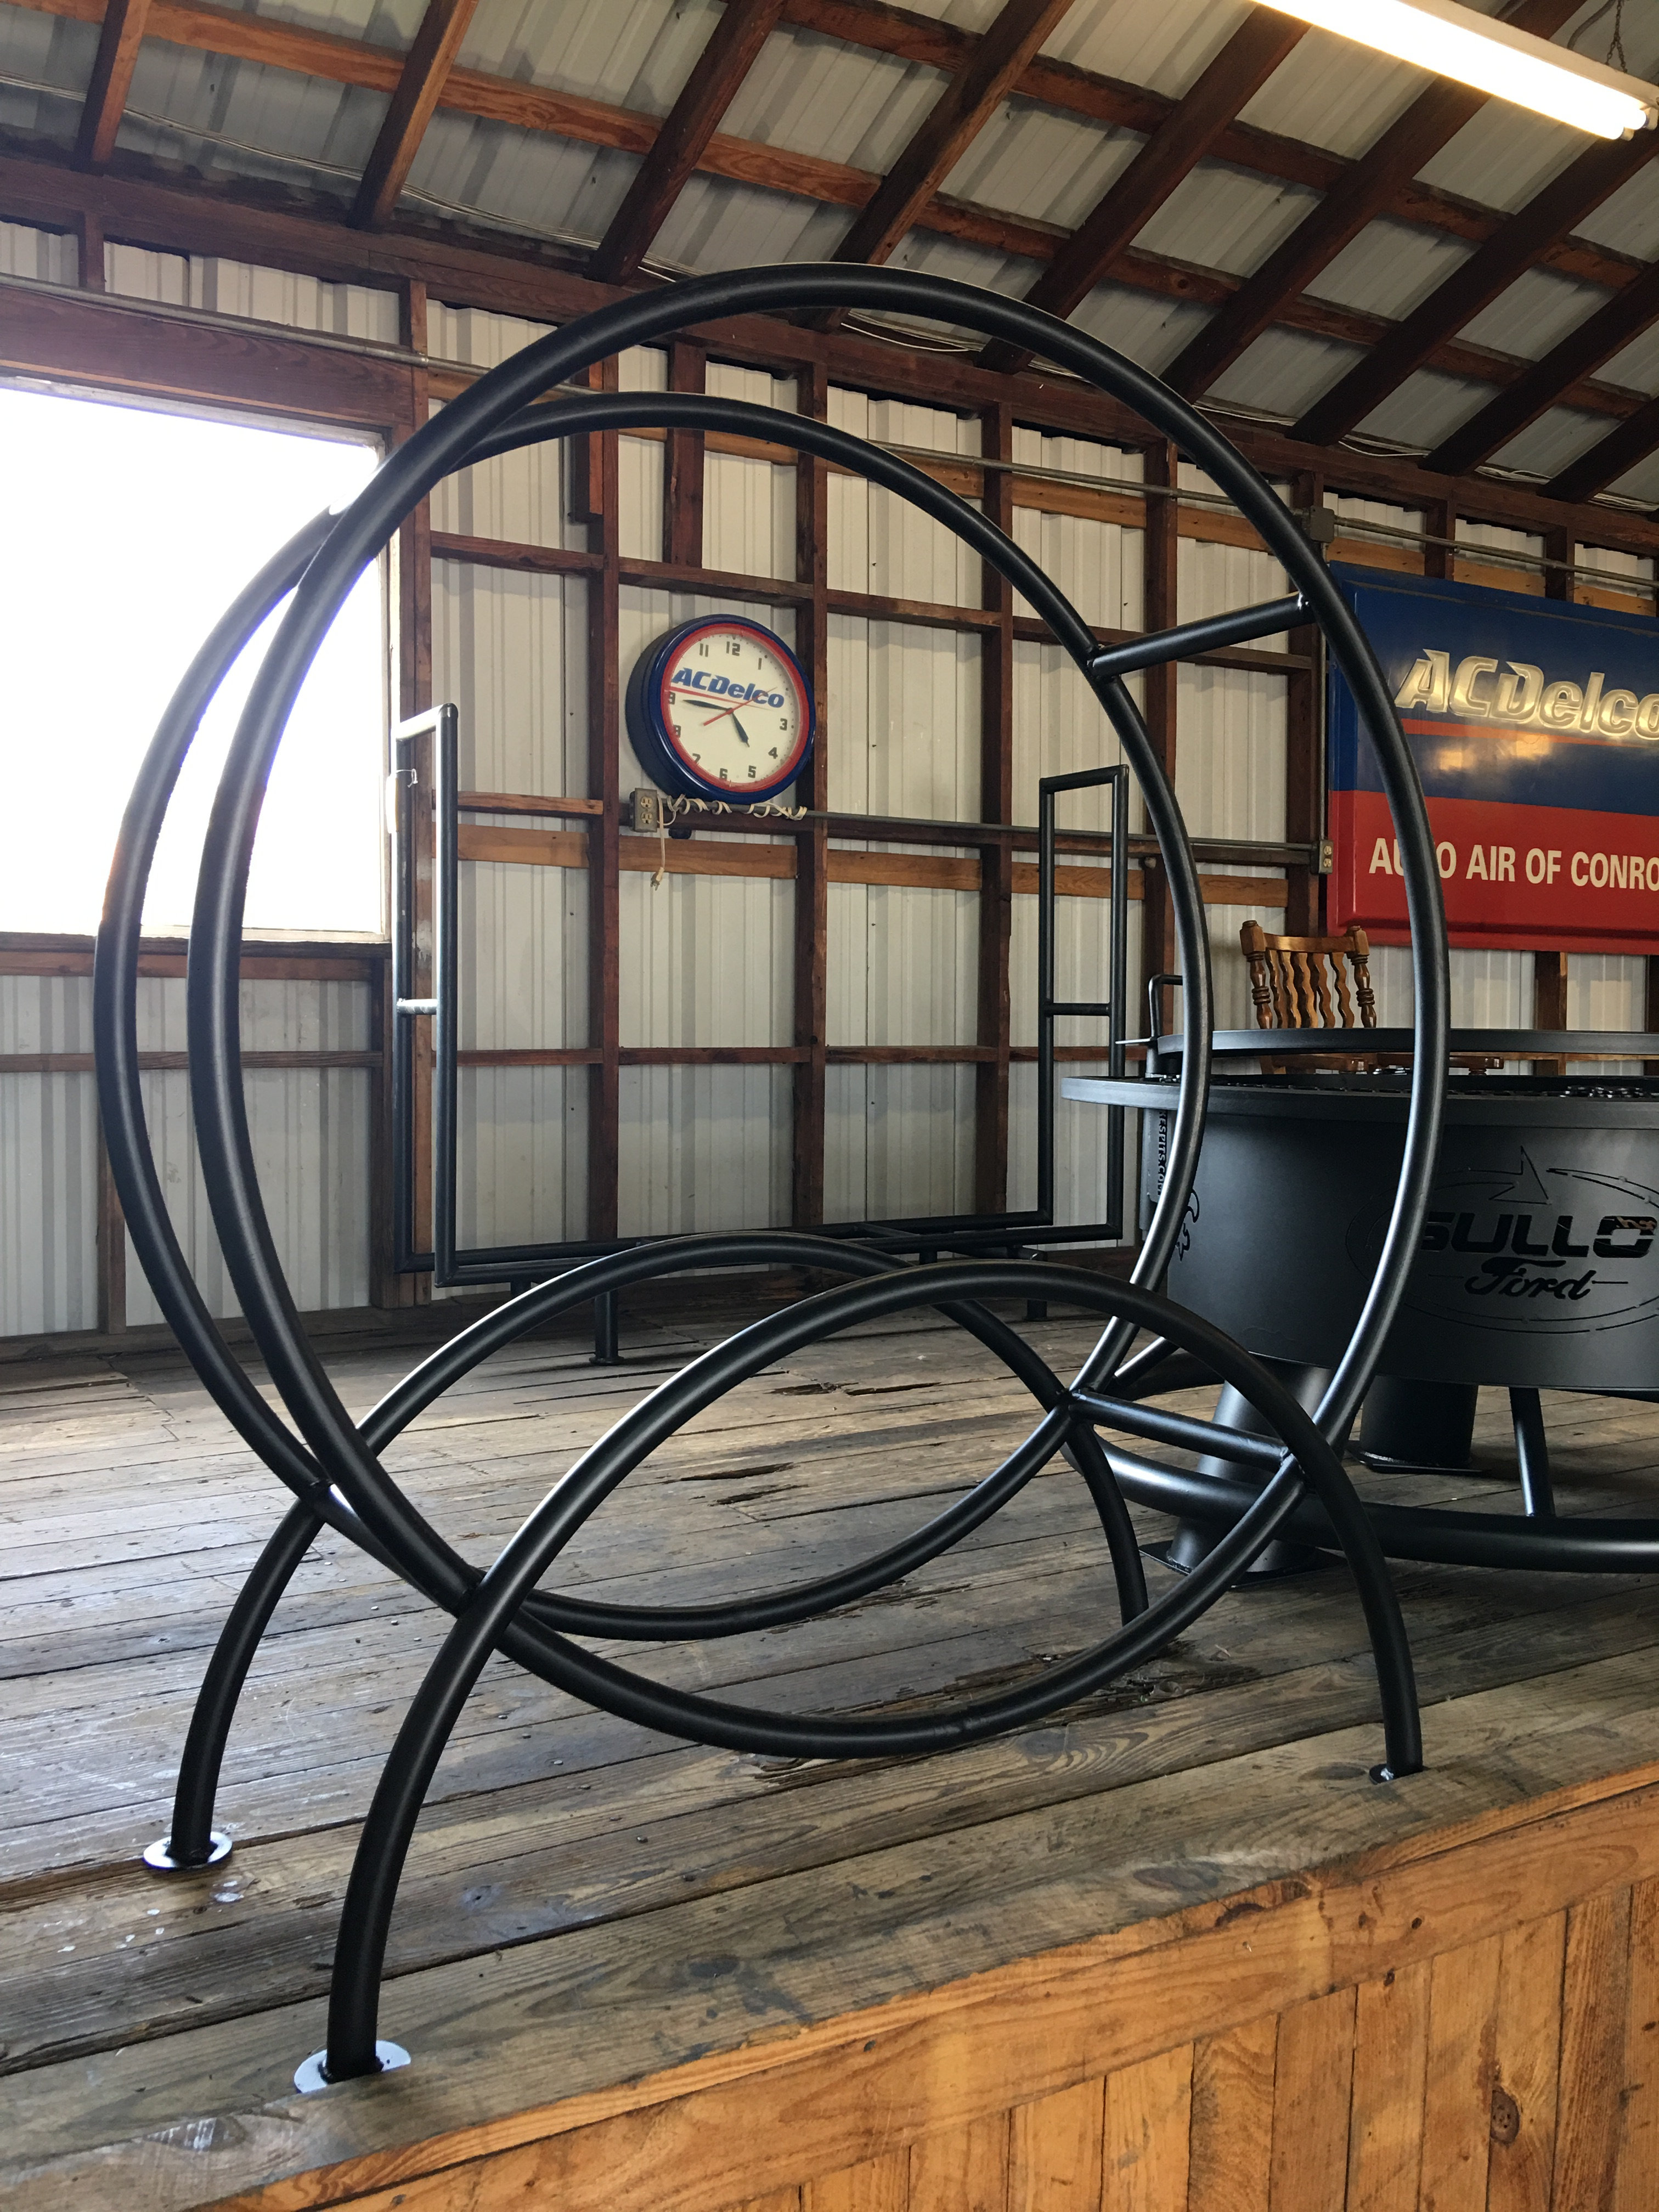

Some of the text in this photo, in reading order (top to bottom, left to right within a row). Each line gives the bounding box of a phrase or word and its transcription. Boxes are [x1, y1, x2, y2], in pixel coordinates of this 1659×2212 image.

[699, 643, 709, 657] 11
[726, 641, 741, 657] 12
[758, 657, 763, 670] 1
[670, 667, 785, 708] ACDelco
[1394, 648, 1659, 740] ACDelco
[673, 724, 681, 739] 8
[779, 718, 788, 731] 3
[692, 752, 701, 765] 7
[768, 747, 778, 759] 4
[719, 768, 729, 780] 6
[747, 765, 757, 778] 5
[1368, 837, 1659, 891] AUO AIR OF CONRO
[1464, 1256, 1597, 1301] Ford
